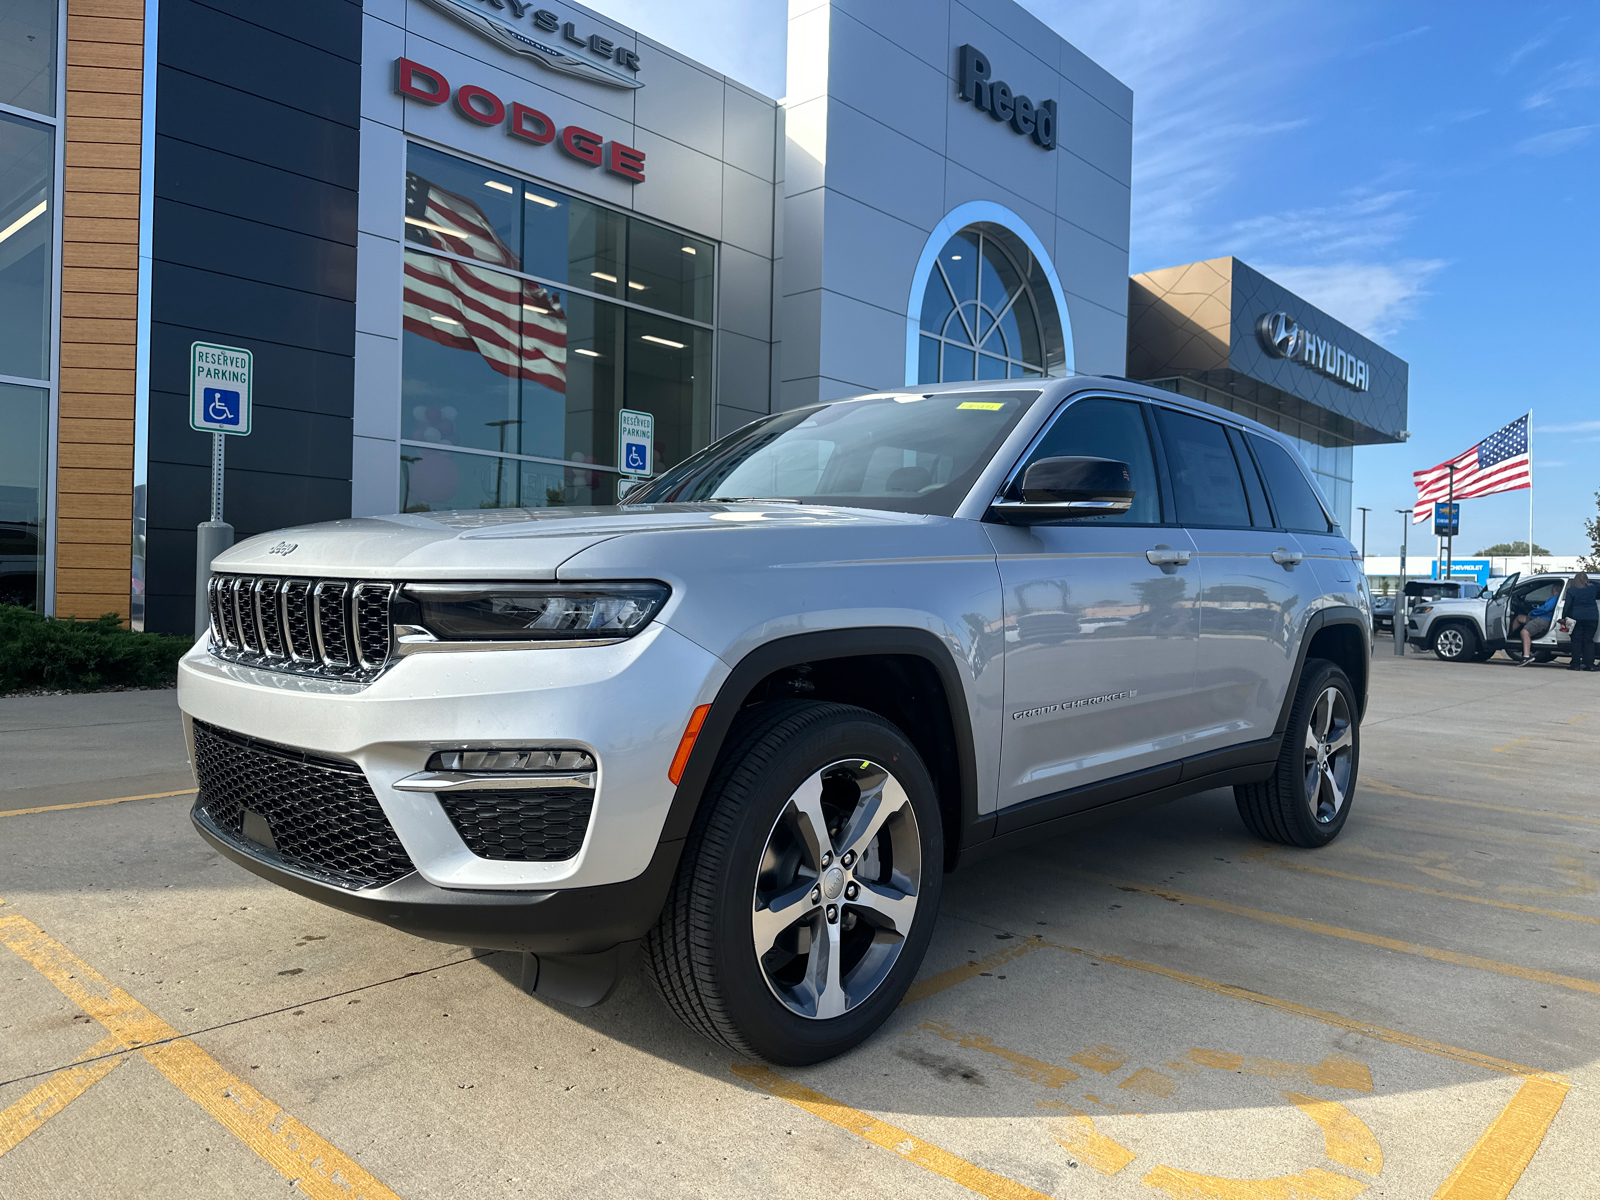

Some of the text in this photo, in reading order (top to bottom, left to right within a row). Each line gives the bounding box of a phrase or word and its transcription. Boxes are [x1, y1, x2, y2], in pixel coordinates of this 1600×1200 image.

[479, 0, 640, 72] YSLER
[511, 32, 558, 56] CHRYSLER
[959, 43, 1057, 151] Reed
[394, 56, 646, 183] DODGE
[198, 351, 246, 369] RESERVED
[1302, 330, 1369, 392] HYUNDAI
[197, 365, 246, 384] PARKING
[622, 426, 650, 439] PARKING
[623, 415, 650, 429] RESERVED
[269, 541, 298, 556] Jeep
[1012, 691, 1128, 720] GRAND CHEROKEE
